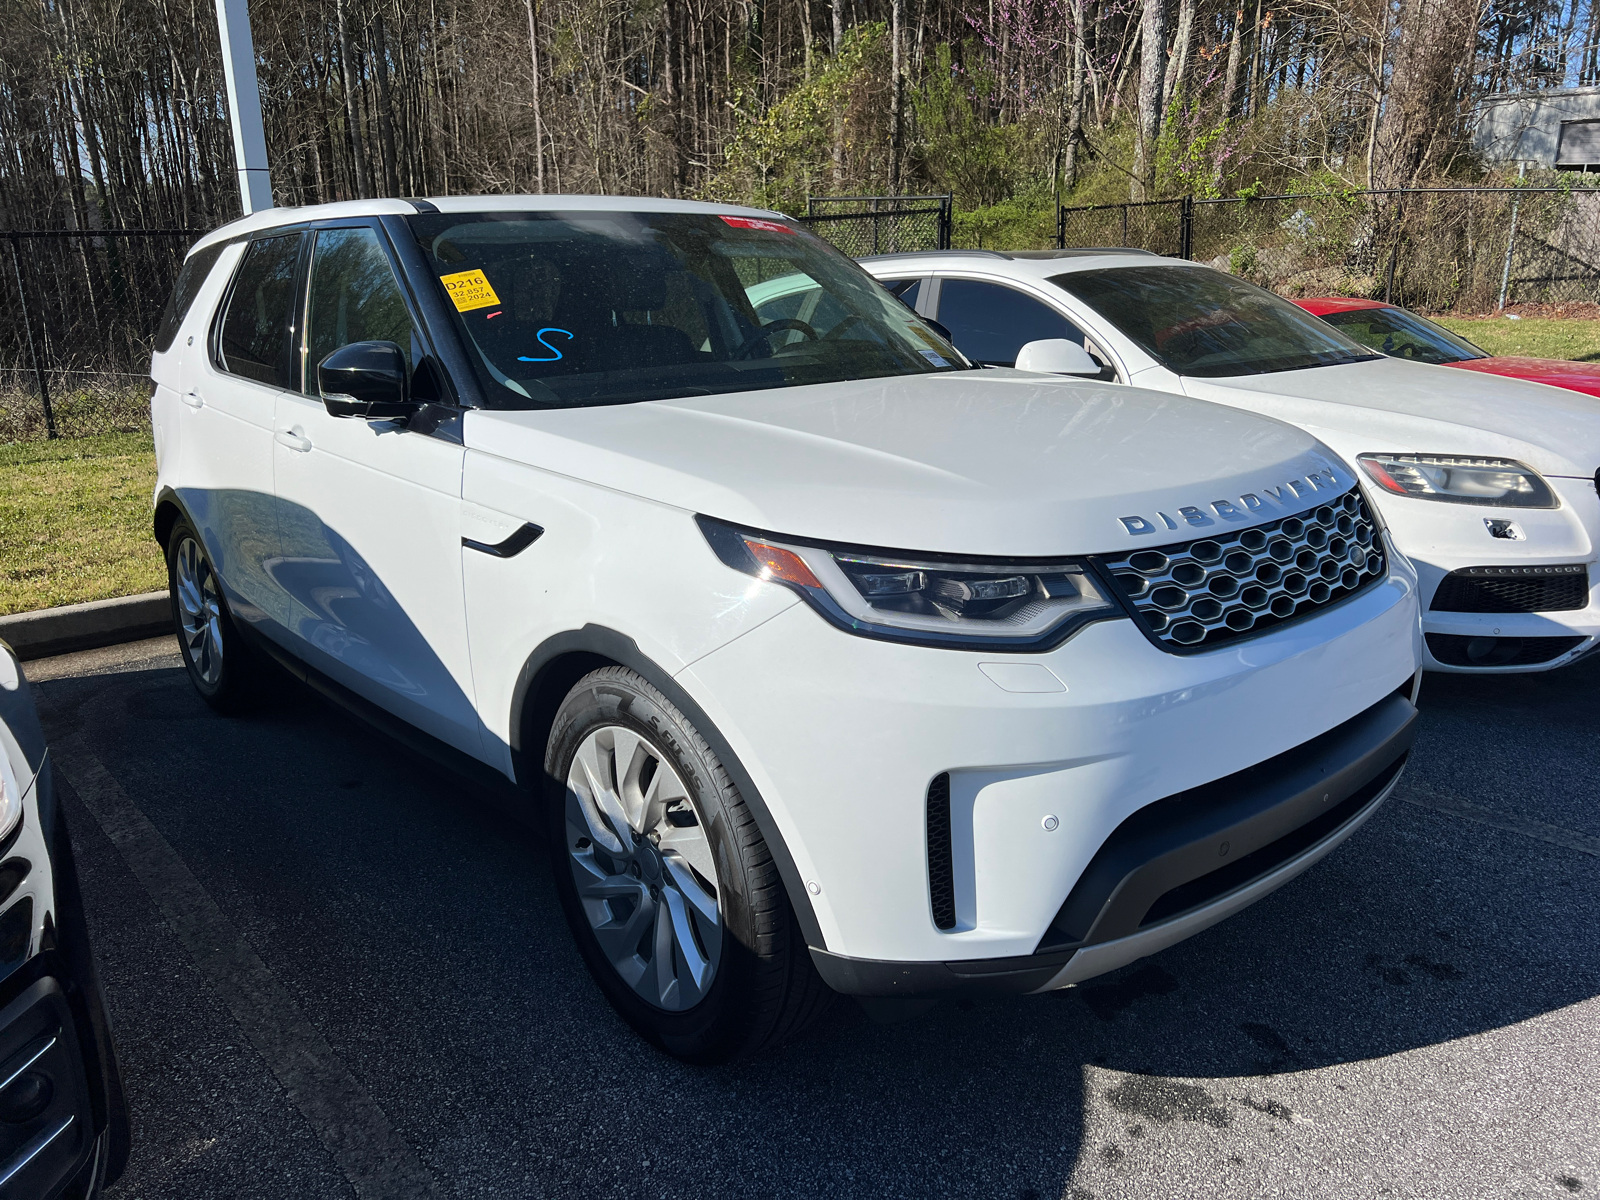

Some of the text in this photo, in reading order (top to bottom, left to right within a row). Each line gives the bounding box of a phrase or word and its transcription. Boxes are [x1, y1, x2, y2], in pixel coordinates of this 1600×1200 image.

[445, 277, 484, 291] D216
[468, 292, 491, 301] 2024
[517, 328, 574, 362] S
[1116, 467, 1337, 536] DISCOVERY
[647, 715, 661, 730] S
[661, 730, 686, 758] FIT
